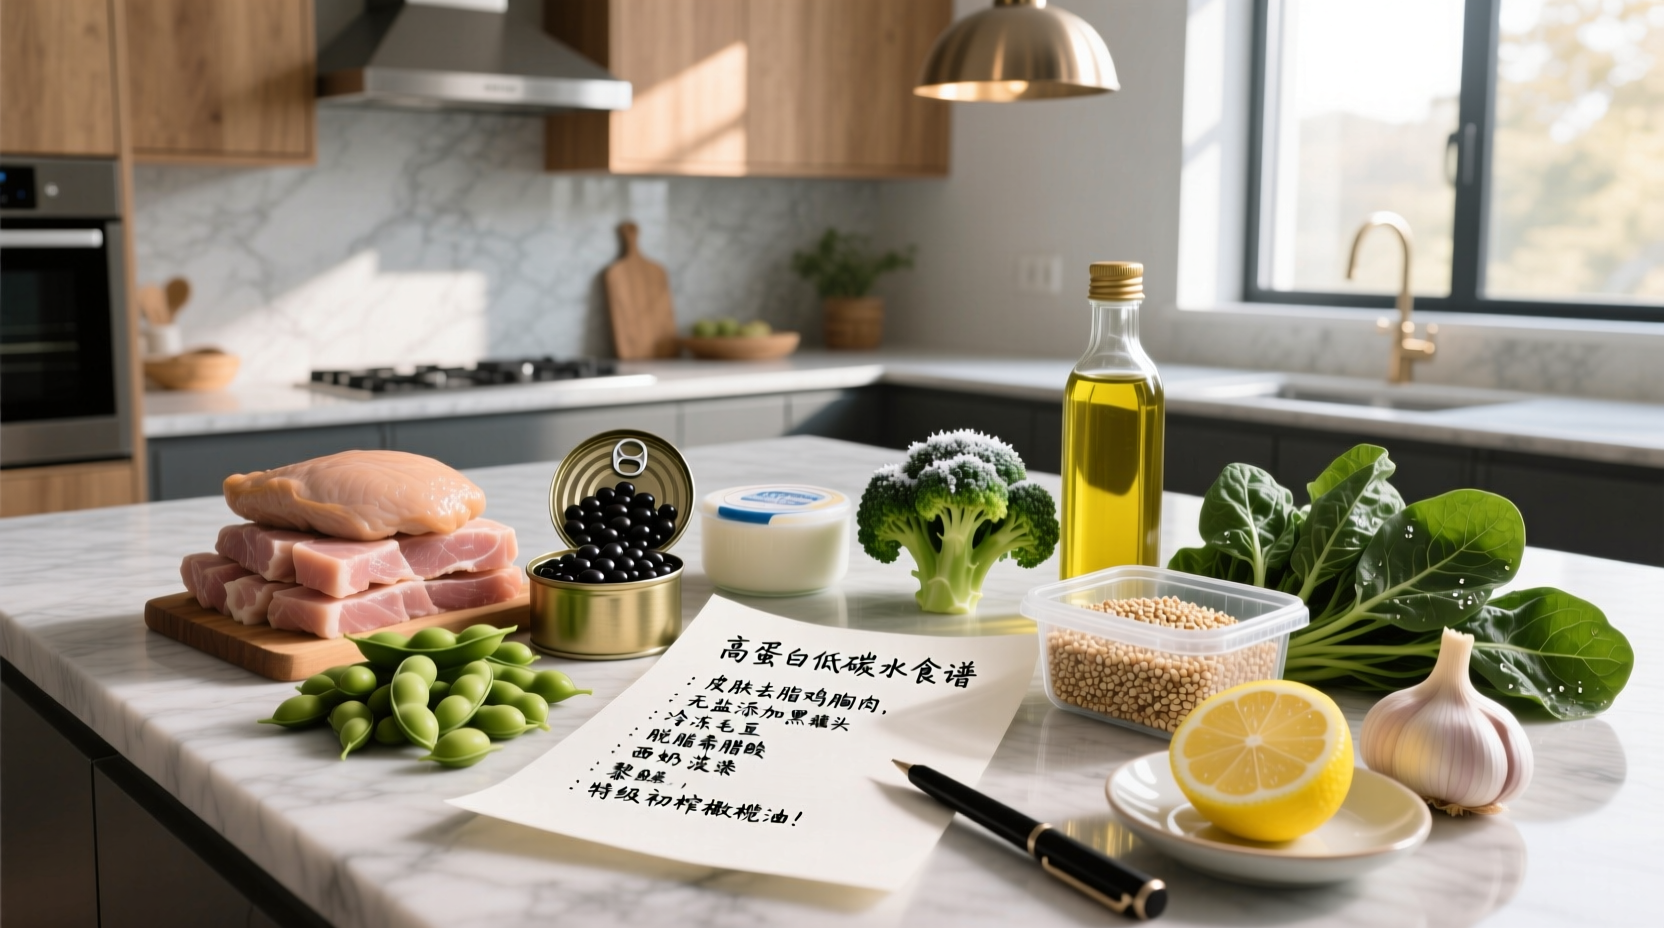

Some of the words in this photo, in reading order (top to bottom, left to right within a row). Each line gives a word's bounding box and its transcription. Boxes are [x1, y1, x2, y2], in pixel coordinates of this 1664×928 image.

[720, 635, 977, 688] 高蛋白低碳水食谱
[664, 709, 760, 736] 冷冻毛豆
